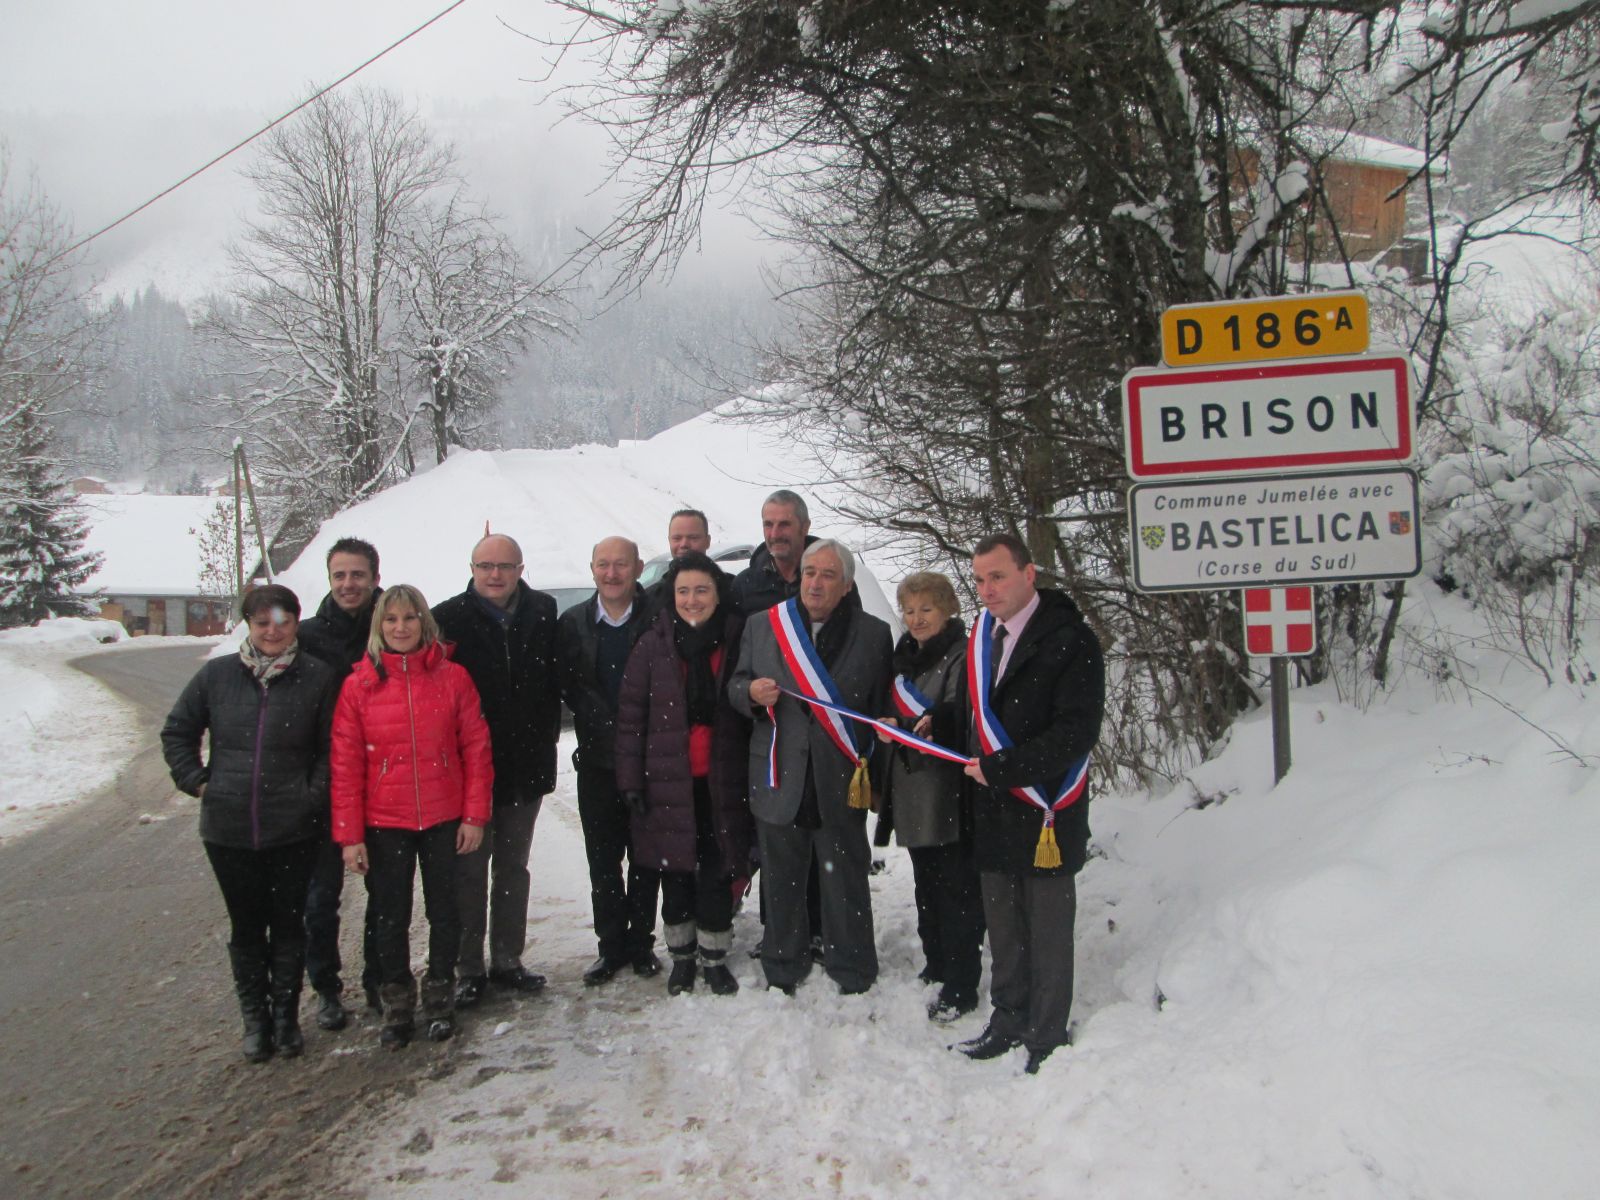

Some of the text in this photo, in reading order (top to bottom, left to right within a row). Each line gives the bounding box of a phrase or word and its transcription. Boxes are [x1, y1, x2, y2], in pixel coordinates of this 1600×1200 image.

[1176, 318, 1203, 356] D
[1160, 391, 1378, 442] BRISON
[1154, 483, 1394, 510] Commune Jumelée avec
[1170, 511, 1380, 552] BASTELICA
[1197, 553, 1357, 578] (Corse du Sud)
